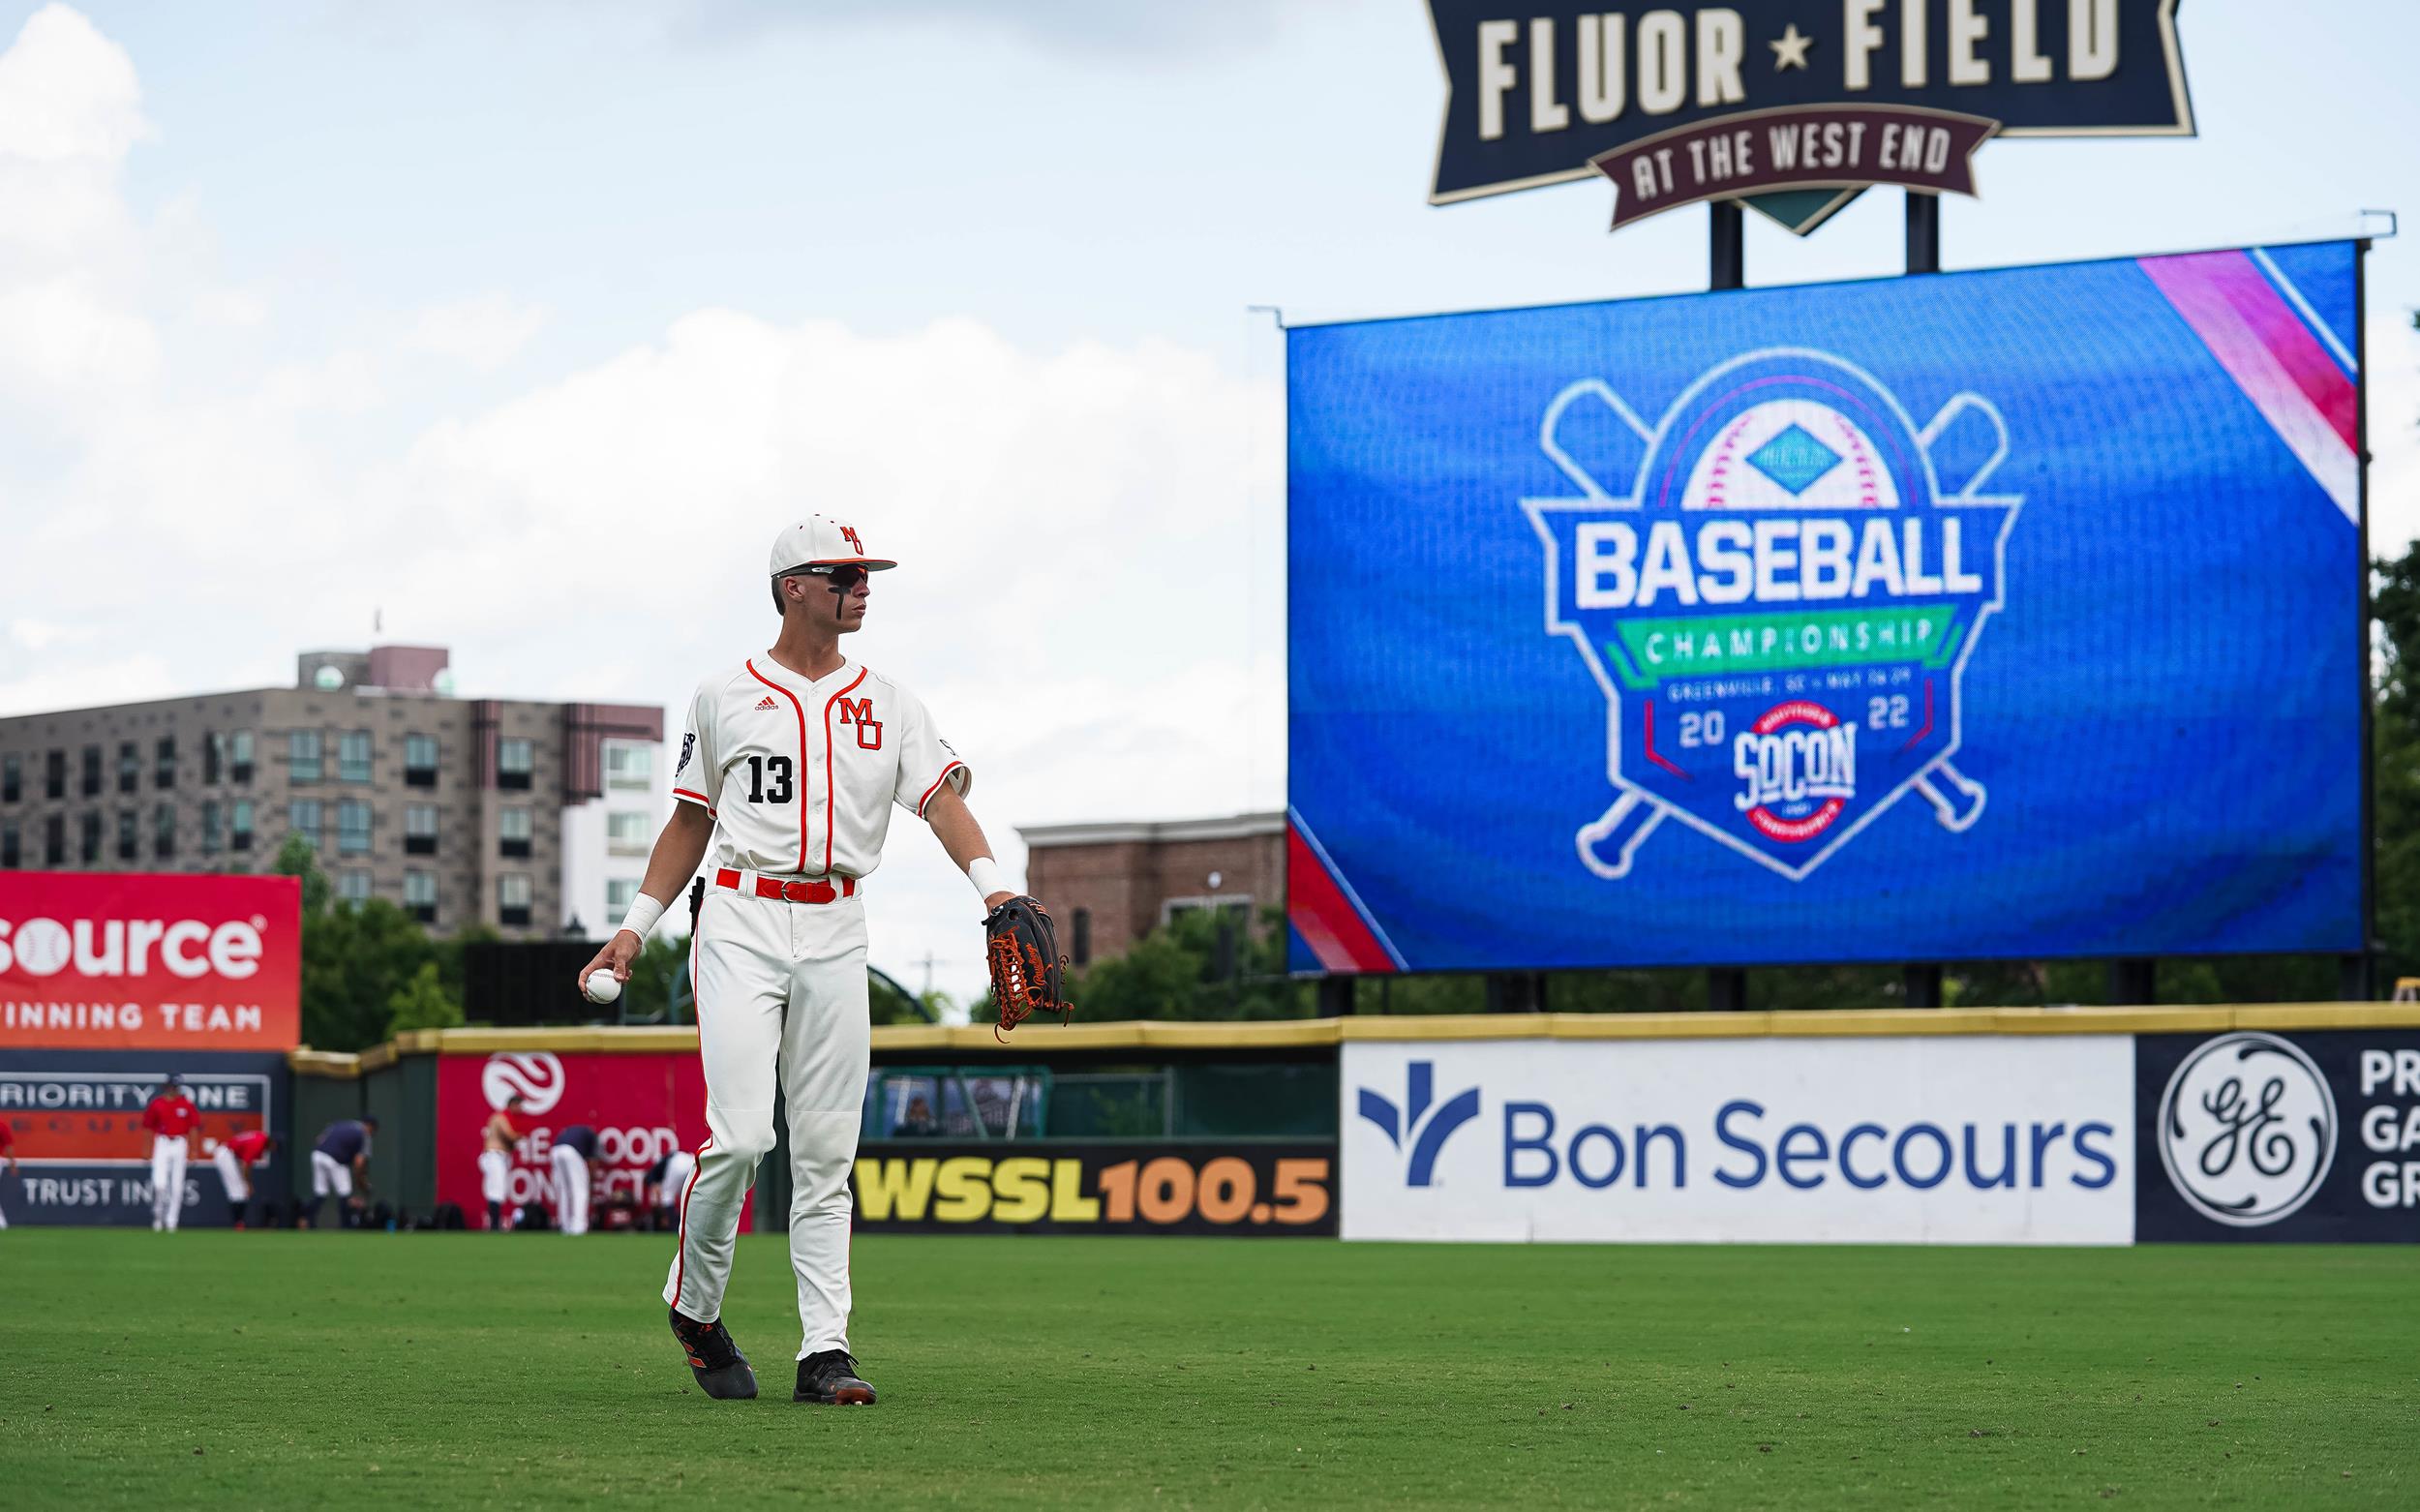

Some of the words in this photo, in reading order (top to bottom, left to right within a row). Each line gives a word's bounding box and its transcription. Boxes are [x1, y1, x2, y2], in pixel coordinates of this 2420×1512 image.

[1478, 7, 1745, 140] FLUOR
[1843, 0, 2119, 90] FIELD
[1632, 148, 1674, 201] AT
[1687, 129, 1754, 185] THE
[1769, 121, 1865, 172] WEST
[1879, 124, 1951, 173] END
[1574, 516, 1982, 610] BASEBALL
[1646, 618, 1933, 665] CHAMPIONSHIP
[1679, 710, 1725, 748] 20
[1867, 693, 1911, 730] 22
[747, 756, 793, 804] 13
[0, 1002, 143, 1031] INNING
[159, 1003, 261, 1032] TEAM
[1503, 1101, 1687, 1188] Bon
[1713, 1100, 2117, 1189] Secours
[23, 1178, 115, 1206] TRUST
